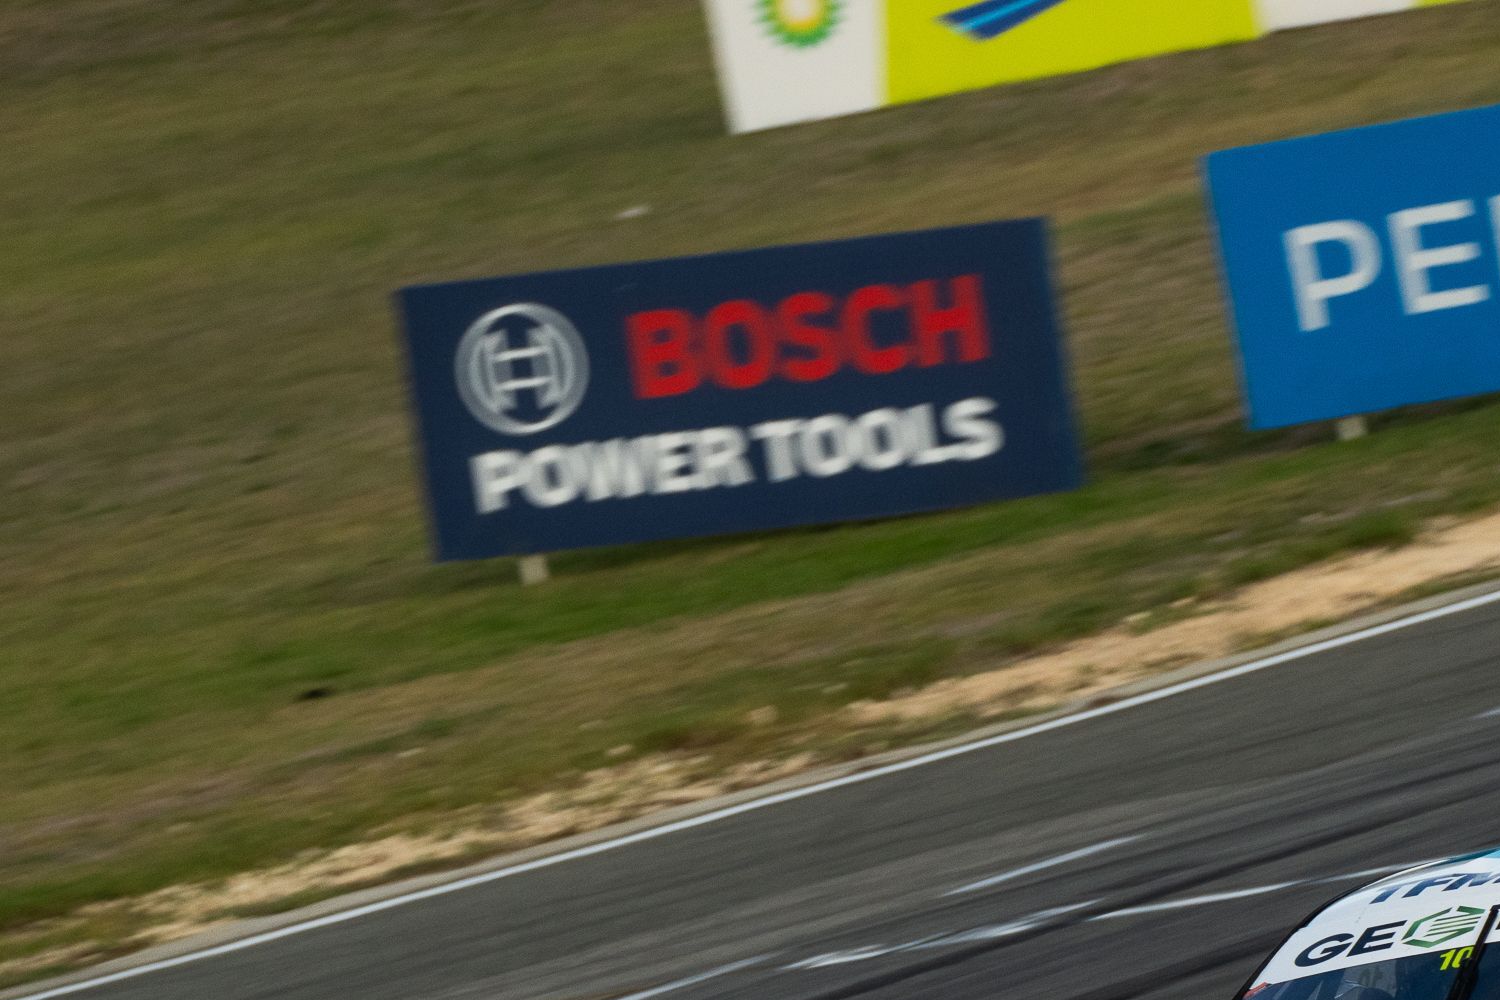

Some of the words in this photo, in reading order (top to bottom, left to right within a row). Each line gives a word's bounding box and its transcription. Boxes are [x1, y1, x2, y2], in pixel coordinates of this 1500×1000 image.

[624, 273, 993, 399] BOSCH
[468, 424, 754, 515] POWER
[749, 397, 1004, 483] TOOLS
